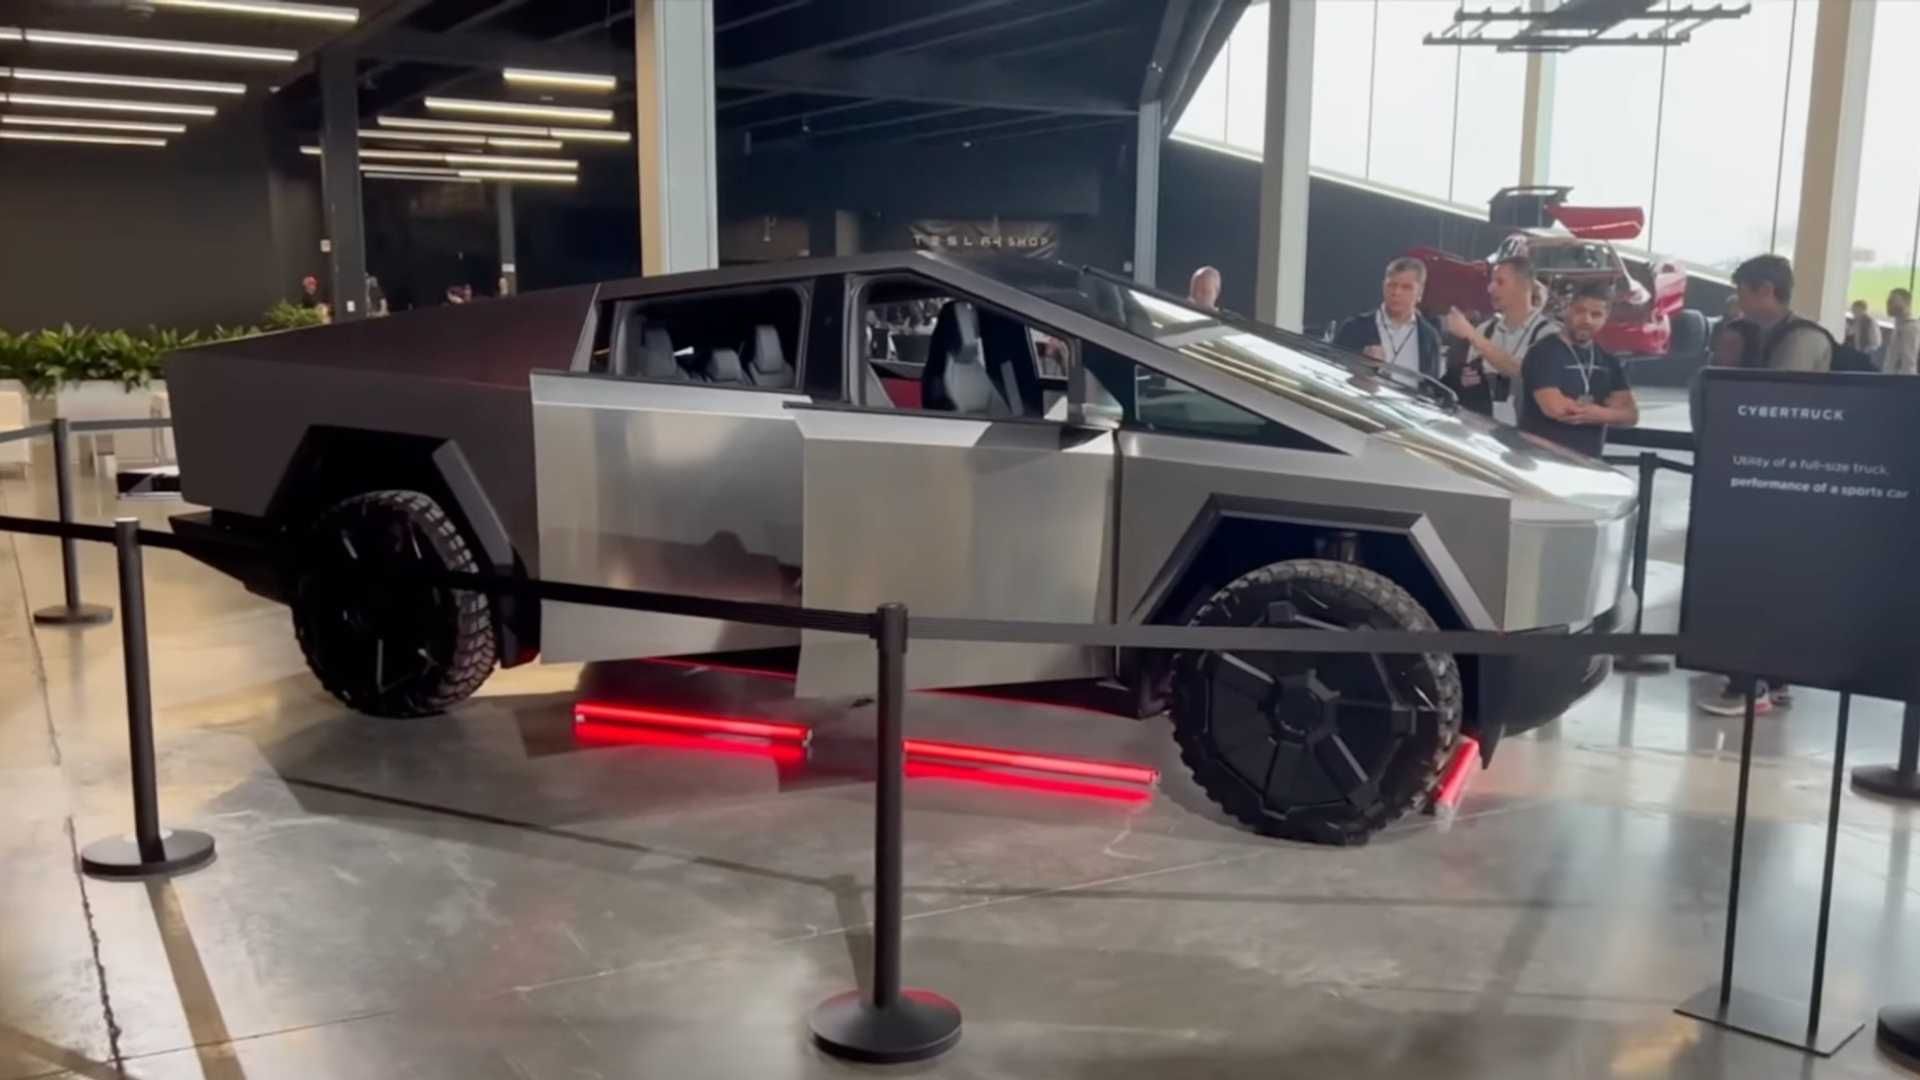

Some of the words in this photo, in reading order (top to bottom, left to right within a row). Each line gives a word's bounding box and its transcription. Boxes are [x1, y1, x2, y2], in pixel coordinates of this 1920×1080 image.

[1737, 404, 1845, 421] CYBERTRUCK
[1732, 455, 1769, 468] Utility
[1773, 457, 1786, 467] of
[1789, 461, 1797, 469] a
[1800, 459, 1849, 473] full-size
[1730, 476, 1809, 493] performance
[1813, 481, 1827, 493] of
[1830, 484, 1838, 495] a
[1841, 485, 1883, 500] sports
[1886, 488, 1909, 499] car
